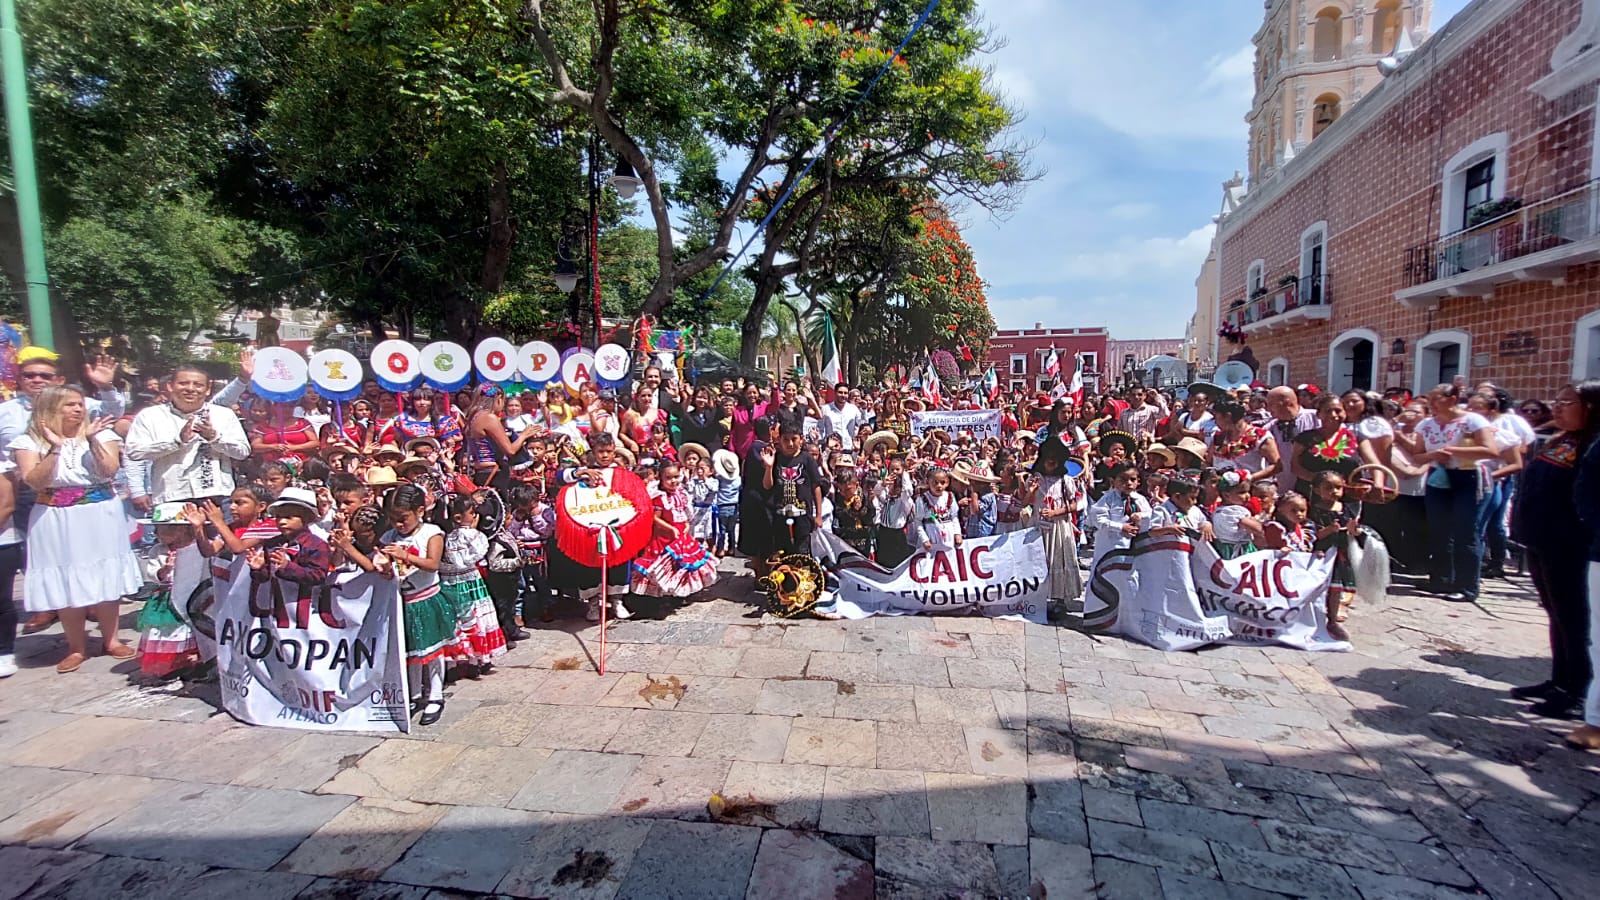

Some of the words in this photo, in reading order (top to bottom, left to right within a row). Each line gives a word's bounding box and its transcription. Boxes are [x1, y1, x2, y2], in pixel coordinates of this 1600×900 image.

[909, 544, 994, 584] CAIC
[1210, 557, 1299, 598] CAIC
[249, 577, 347, 629] CAIC
[888, 576, 1040, 606] EVOLUCIÓN
[220, 618, 377, 670] AXOOPAN
[1241, 624, 1276, 638] DIF
[298, 687, 337, 712] DIF
[371, 687, 405, 704] CAIC
[277, 705, 338, 725] ATLIXCO
